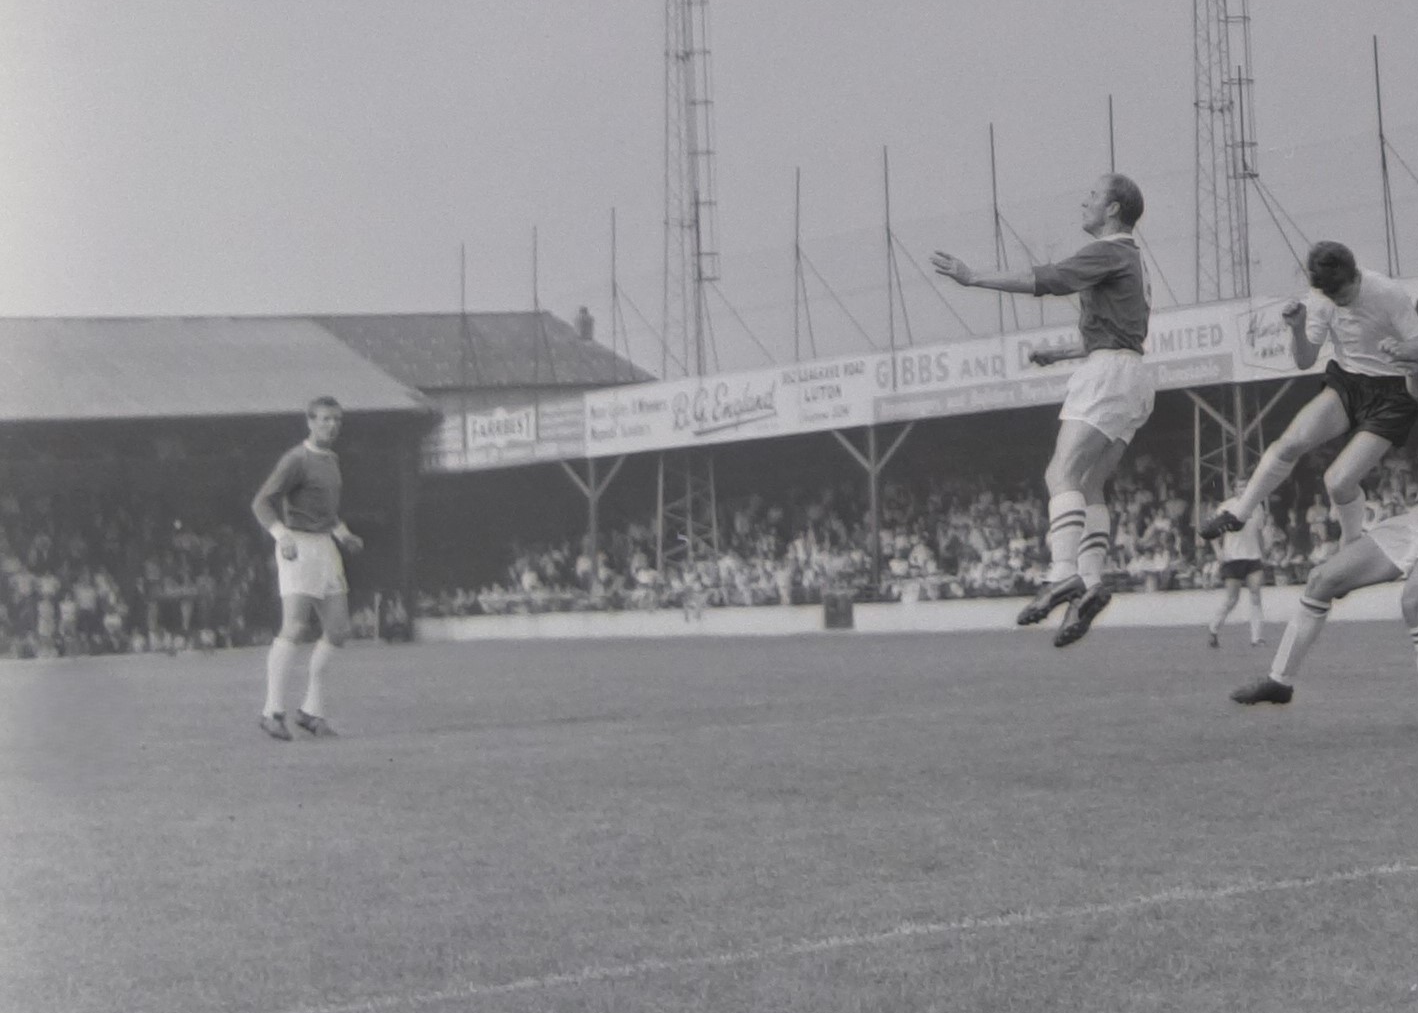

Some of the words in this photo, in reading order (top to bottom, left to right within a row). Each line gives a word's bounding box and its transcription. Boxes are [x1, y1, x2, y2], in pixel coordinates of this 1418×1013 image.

[875, 351, 950, 390] GIBBS
[960, 353, 1006, 379] AND
[1152, 323, 1224, 354] IMITED
